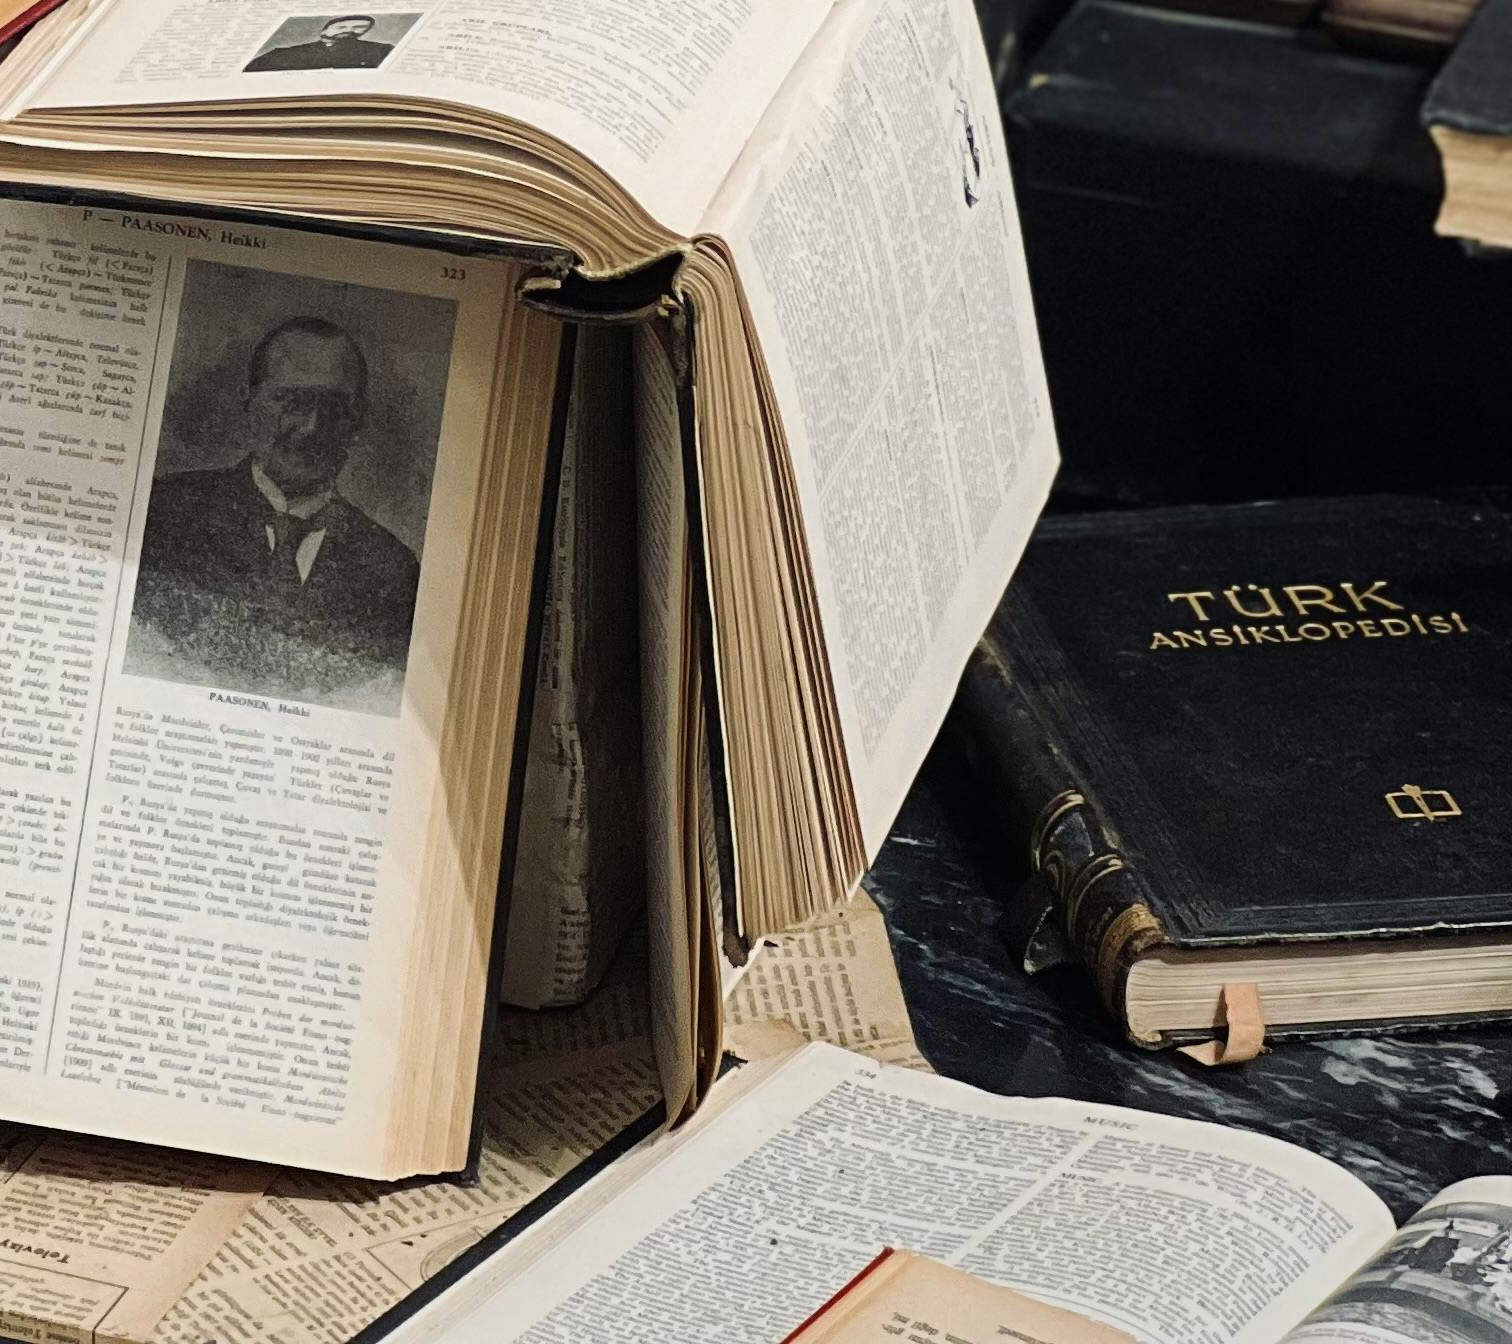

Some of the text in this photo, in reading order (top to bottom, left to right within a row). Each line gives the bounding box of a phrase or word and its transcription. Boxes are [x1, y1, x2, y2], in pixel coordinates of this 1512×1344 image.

[83, 210, 93, 221] P
[122, 216, 212, 241] PAASONEN,
[221, 231, 266, 249] Heikki
[440, 266, 467, 283] 323
[1168, 580, 1406, 622] TÜRK
[1149, 611, 1470, 651] ANSİKLOPEDİSİ
[209, 691, 274, 711] PAASONEN,
[1084, 1116, 1139, 1130] MUSIC
